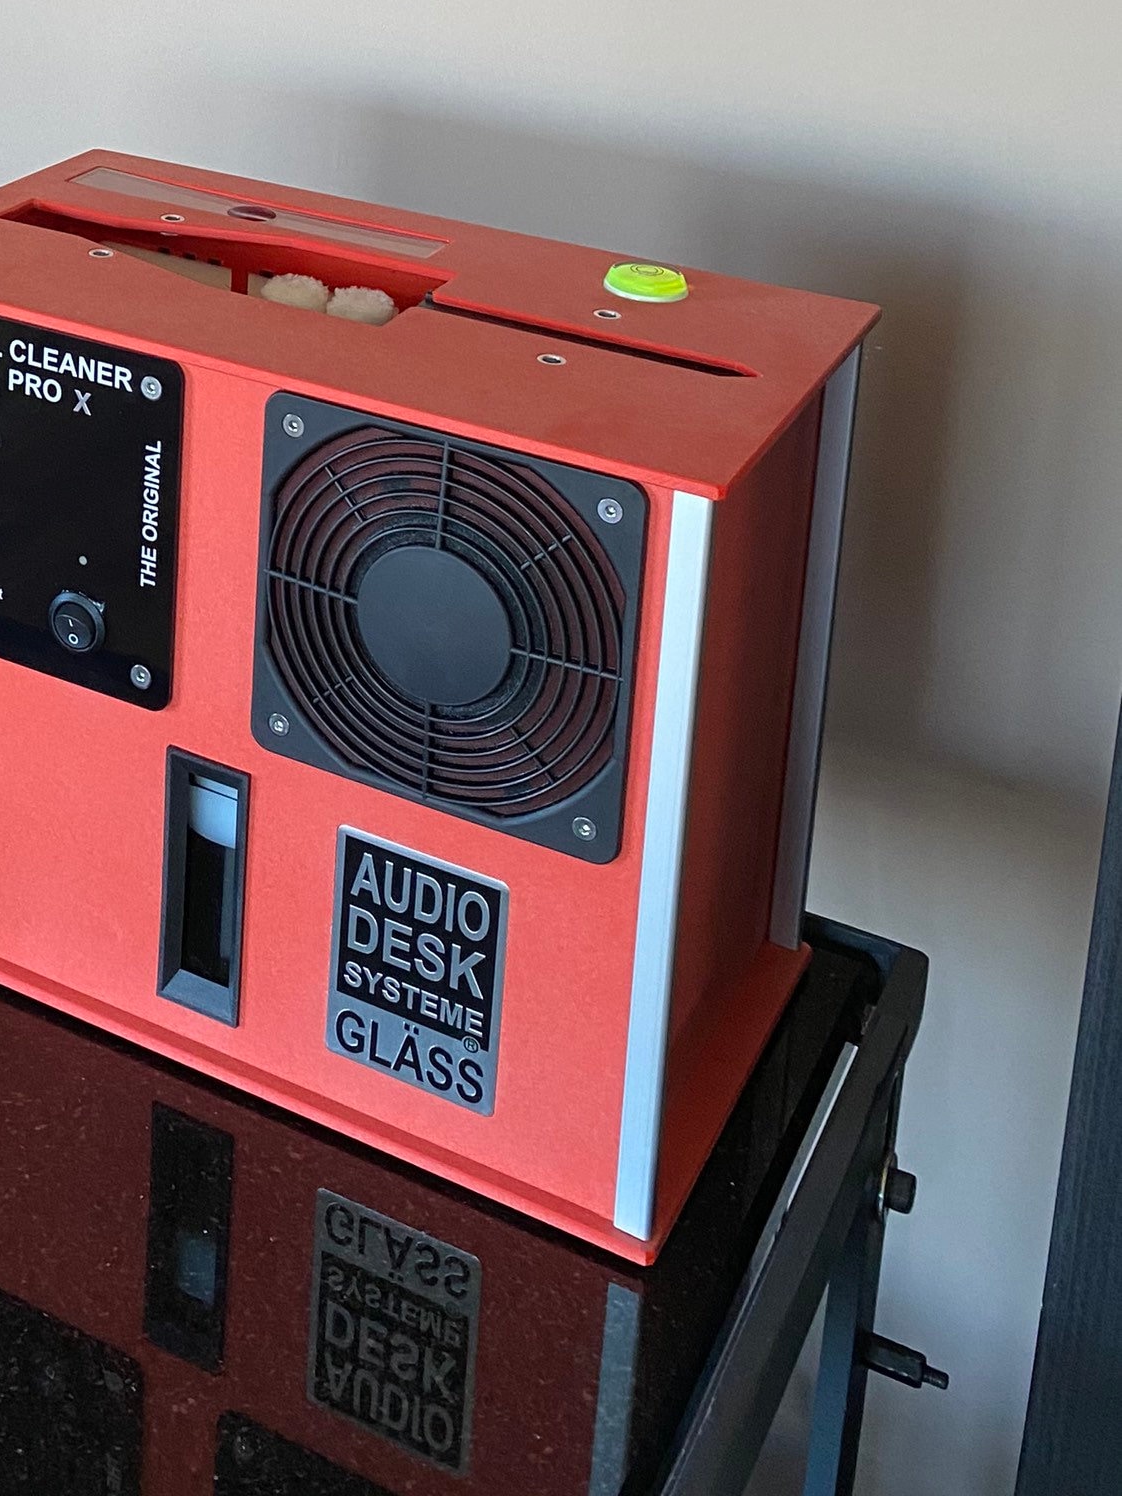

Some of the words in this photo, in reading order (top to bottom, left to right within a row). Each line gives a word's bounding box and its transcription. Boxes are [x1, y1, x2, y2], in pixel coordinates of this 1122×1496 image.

[8, 368, 63, 403] PRO
[73, 388, 92, 416] X
[9, 339, 133, 393] CLEANER
[142, 440, 162, 543] ORIGINAL
[140, 545, 157, 588] THE
[350, 852, 491, 941] AUDIO
[347, 904, 486, 1000] DESK
[343, 961, 484, 1037] SYSTEME
[335, 1008, 484, 1104] GLÄSS
